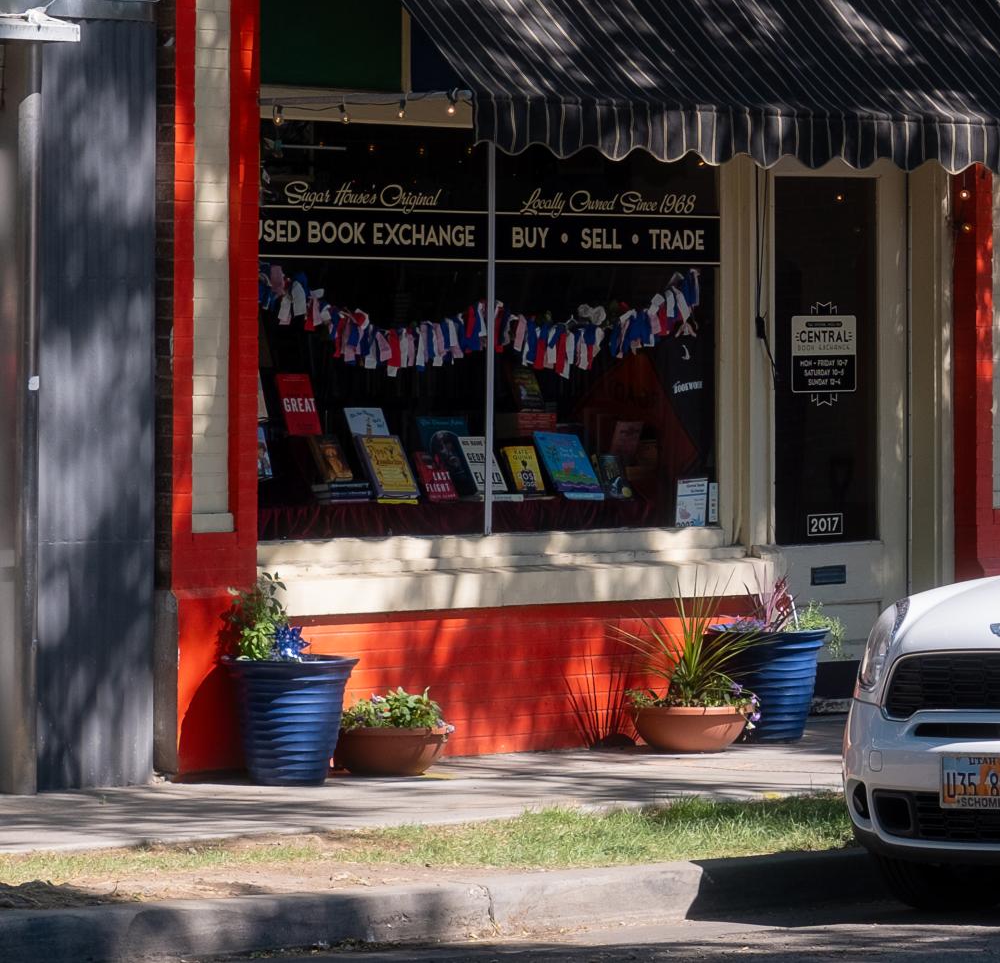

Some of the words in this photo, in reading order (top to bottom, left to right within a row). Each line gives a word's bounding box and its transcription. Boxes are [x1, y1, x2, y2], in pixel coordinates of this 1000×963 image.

[283, 180, 331, 212] Sugar
[333, 181, 378, 206] House's
[379, 183, 443, 215] Original
[519, 187, 566, 219] Locally
[568, 189, 619, 213] Owned
[619, 190, 658, 214] Since
[659, 193, 697, 215] 1968
[307, 220, 367, 245] BOOK
[372, 221, 477, 248] EXCHANGE
[511, 225, 550, 249] BUY
[580, 226, 623, 251] SELL
[648, 228, 706, 251] TRADE
[799, 330, 849, 343] CENTRAL
[803, 368, 831, 377] SATURDAY
[282, 397, 317, 413] GREAT
[432, 470, 451, 481] LAST
[425, 482, 451, 494] FLIGHT
[810, 516, 840, 533] 2017
